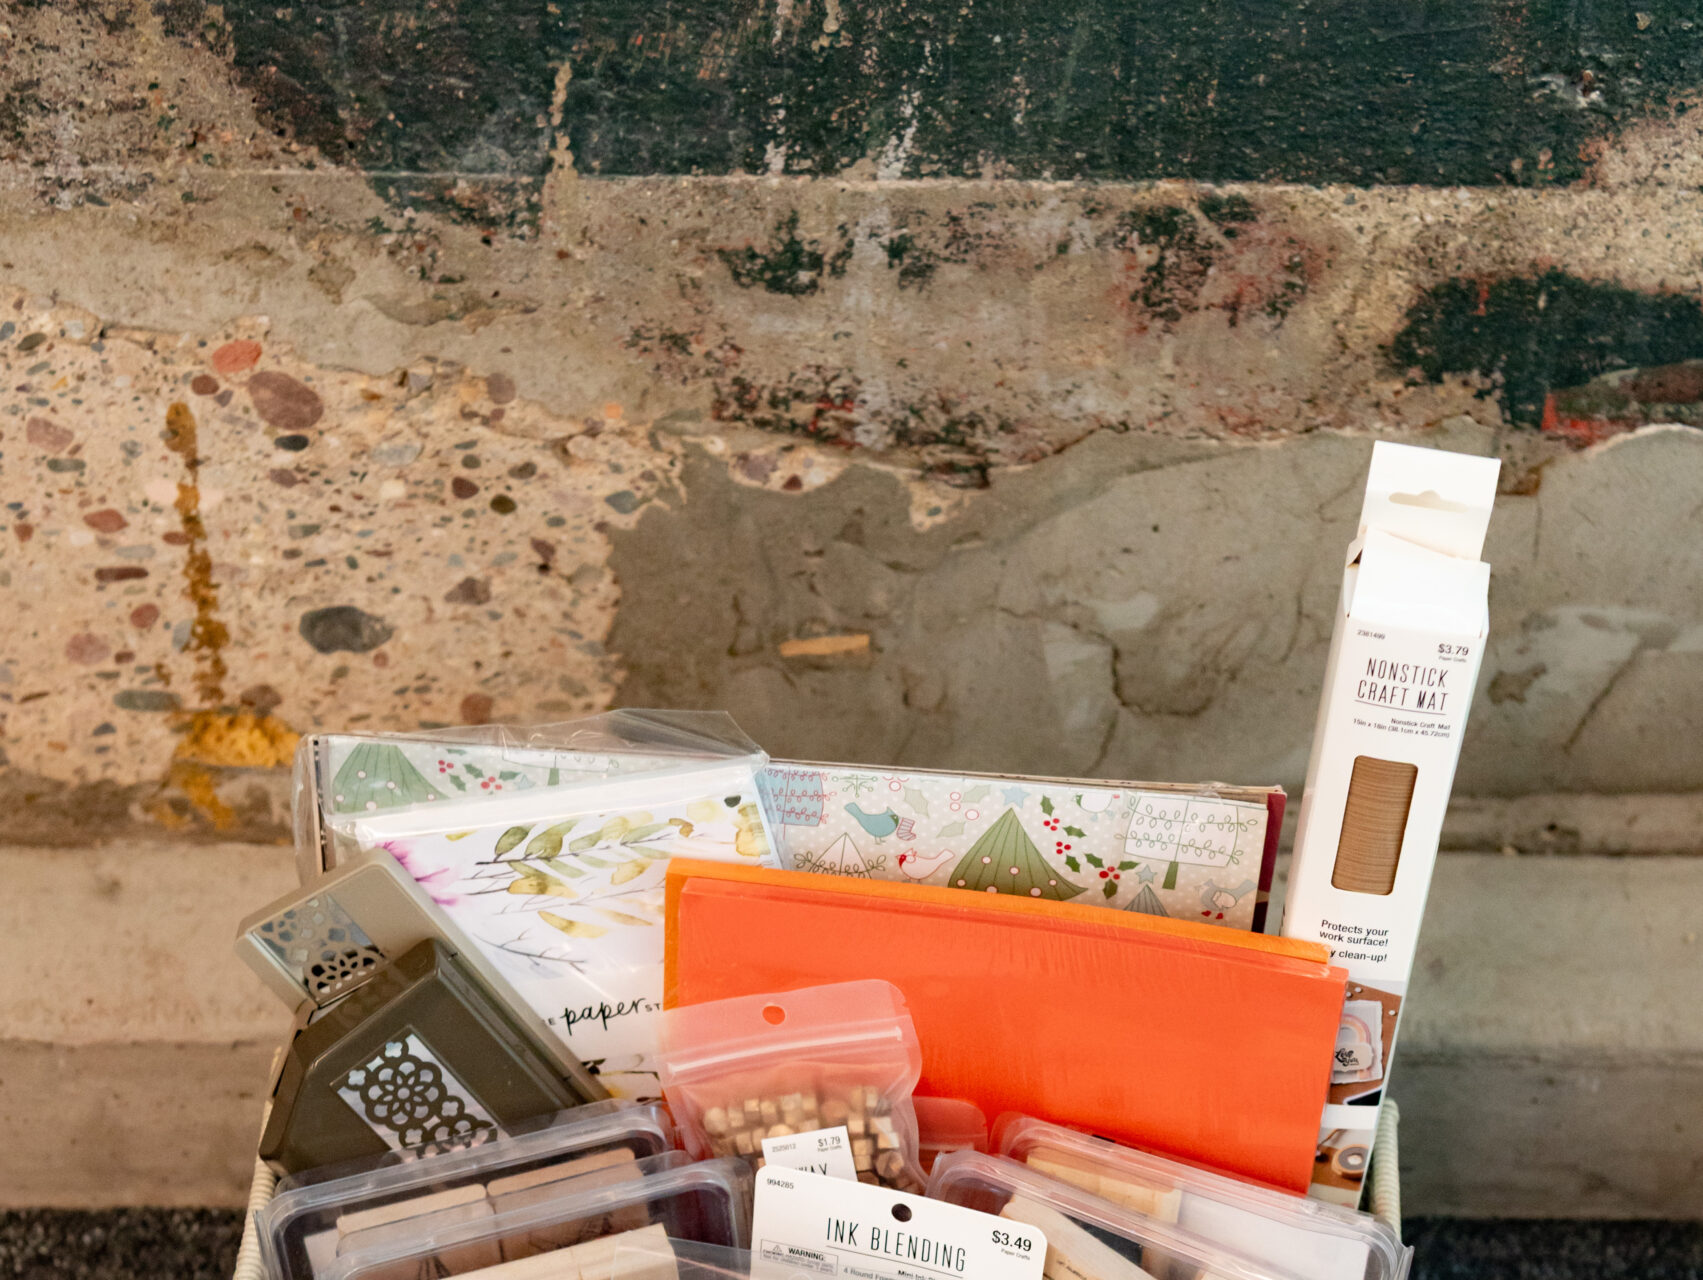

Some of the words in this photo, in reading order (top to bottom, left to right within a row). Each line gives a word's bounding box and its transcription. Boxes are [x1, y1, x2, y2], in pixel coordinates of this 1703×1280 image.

[1438, 643, 1469, 656] $3.79
[1366, 657, 1448, 688] NONSTICK
[1357, 679, 1410, 706] CRAFT
[1416, 690, 1448, 711] MAT
[1391, 718, 1418, 727] Nonstick
[1420, 721, 1435, 729] Craft
[1321, 919, 1363, 934] Protects
[1366, 928, 1389, 937] your
[1319, 931, 1344, 942] work
[1346, 937, 1389, 947] surface!
[1338, 950, 1388, 963] clean-up!
[559, 998, 647, 1036] paper
[818, 1136, 841, 1147] $1.79
[827, 1217, 859, 1247] INK
[870, 1227, 967, 1272] BLENDING
[992, 1230, 1032, 1252] $3.49
[850, 1269, 873, 1280] Round
[898, 1270, 913, 1279] Mini
